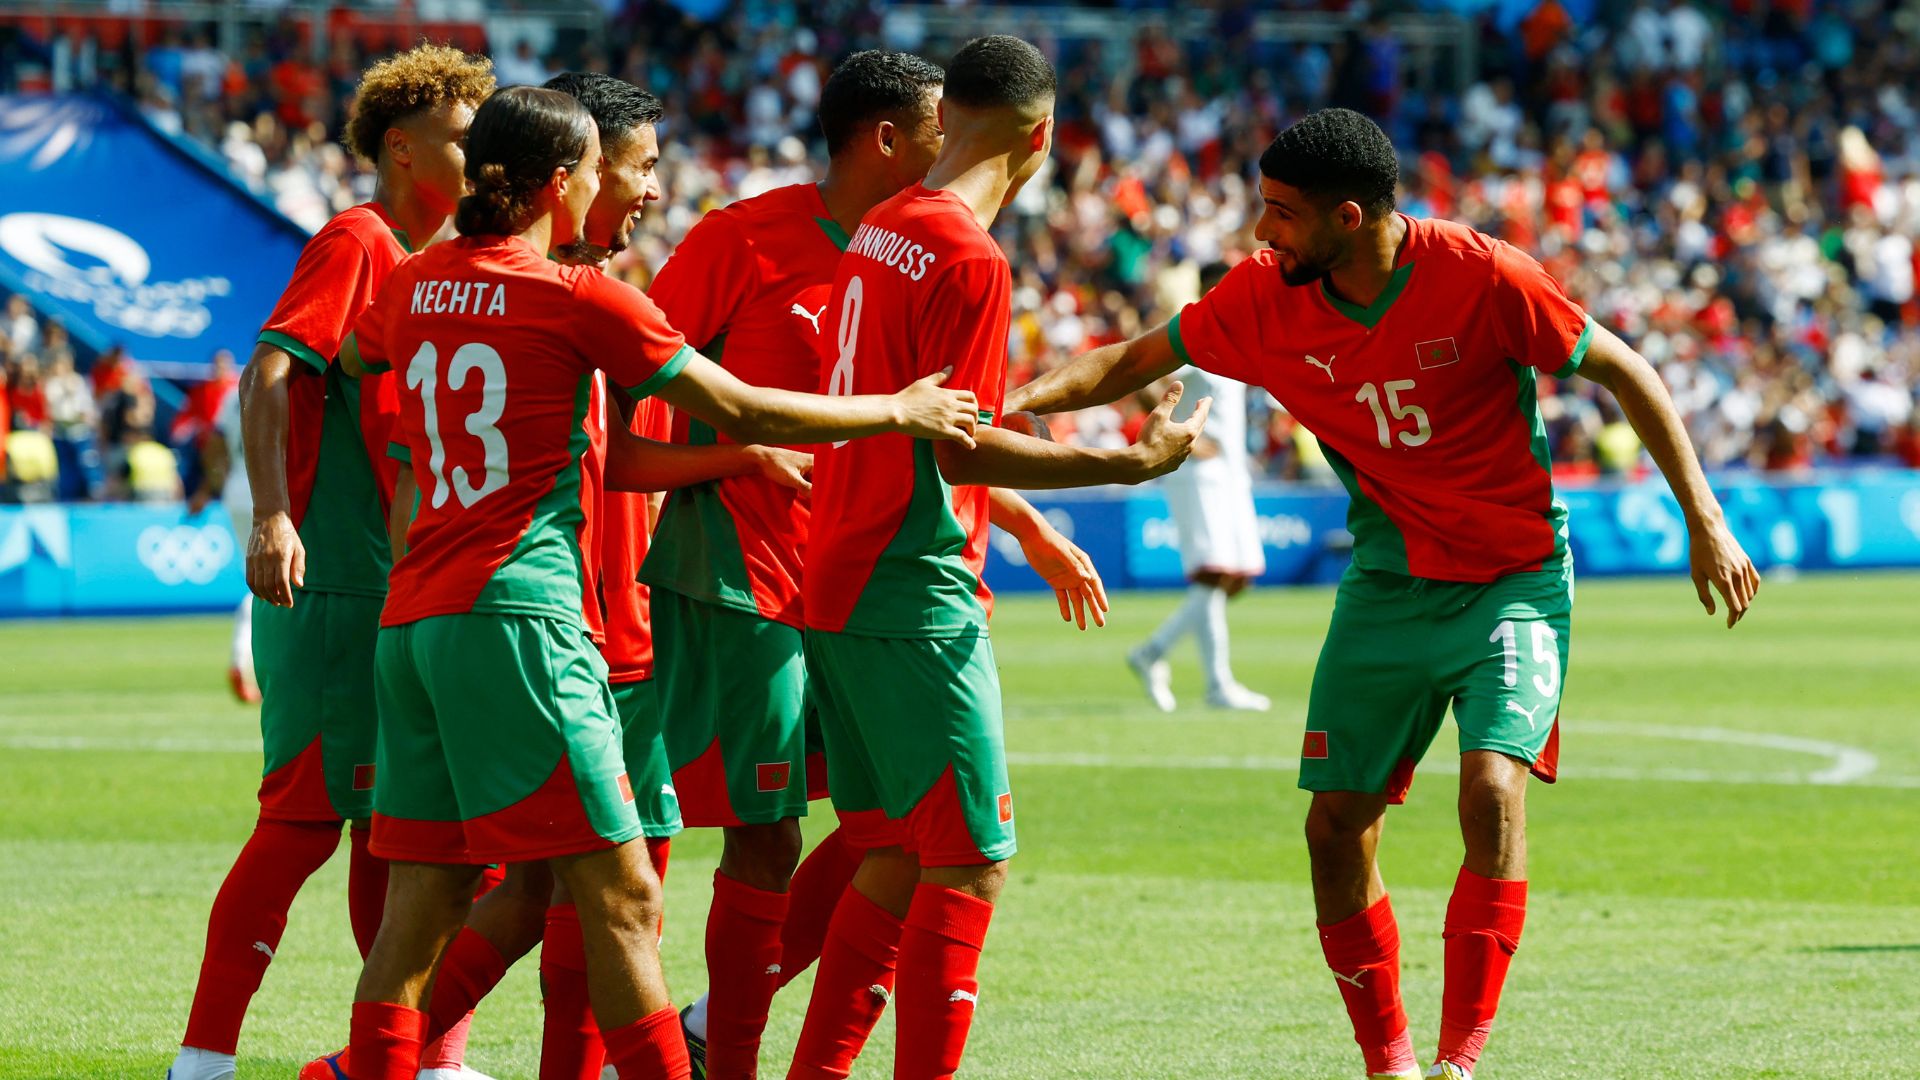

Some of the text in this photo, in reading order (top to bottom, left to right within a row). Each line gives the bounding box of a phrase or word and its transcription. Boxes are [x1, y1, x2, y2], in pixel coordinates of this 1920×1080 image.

[411, 280, 506, 316] KECHTA
[828, 275, 863, 449] 8
[406, 340, 510, 509] 13
[1355, 379, 1432, 449] 15
[1489, 620, 1559, 698] 15
